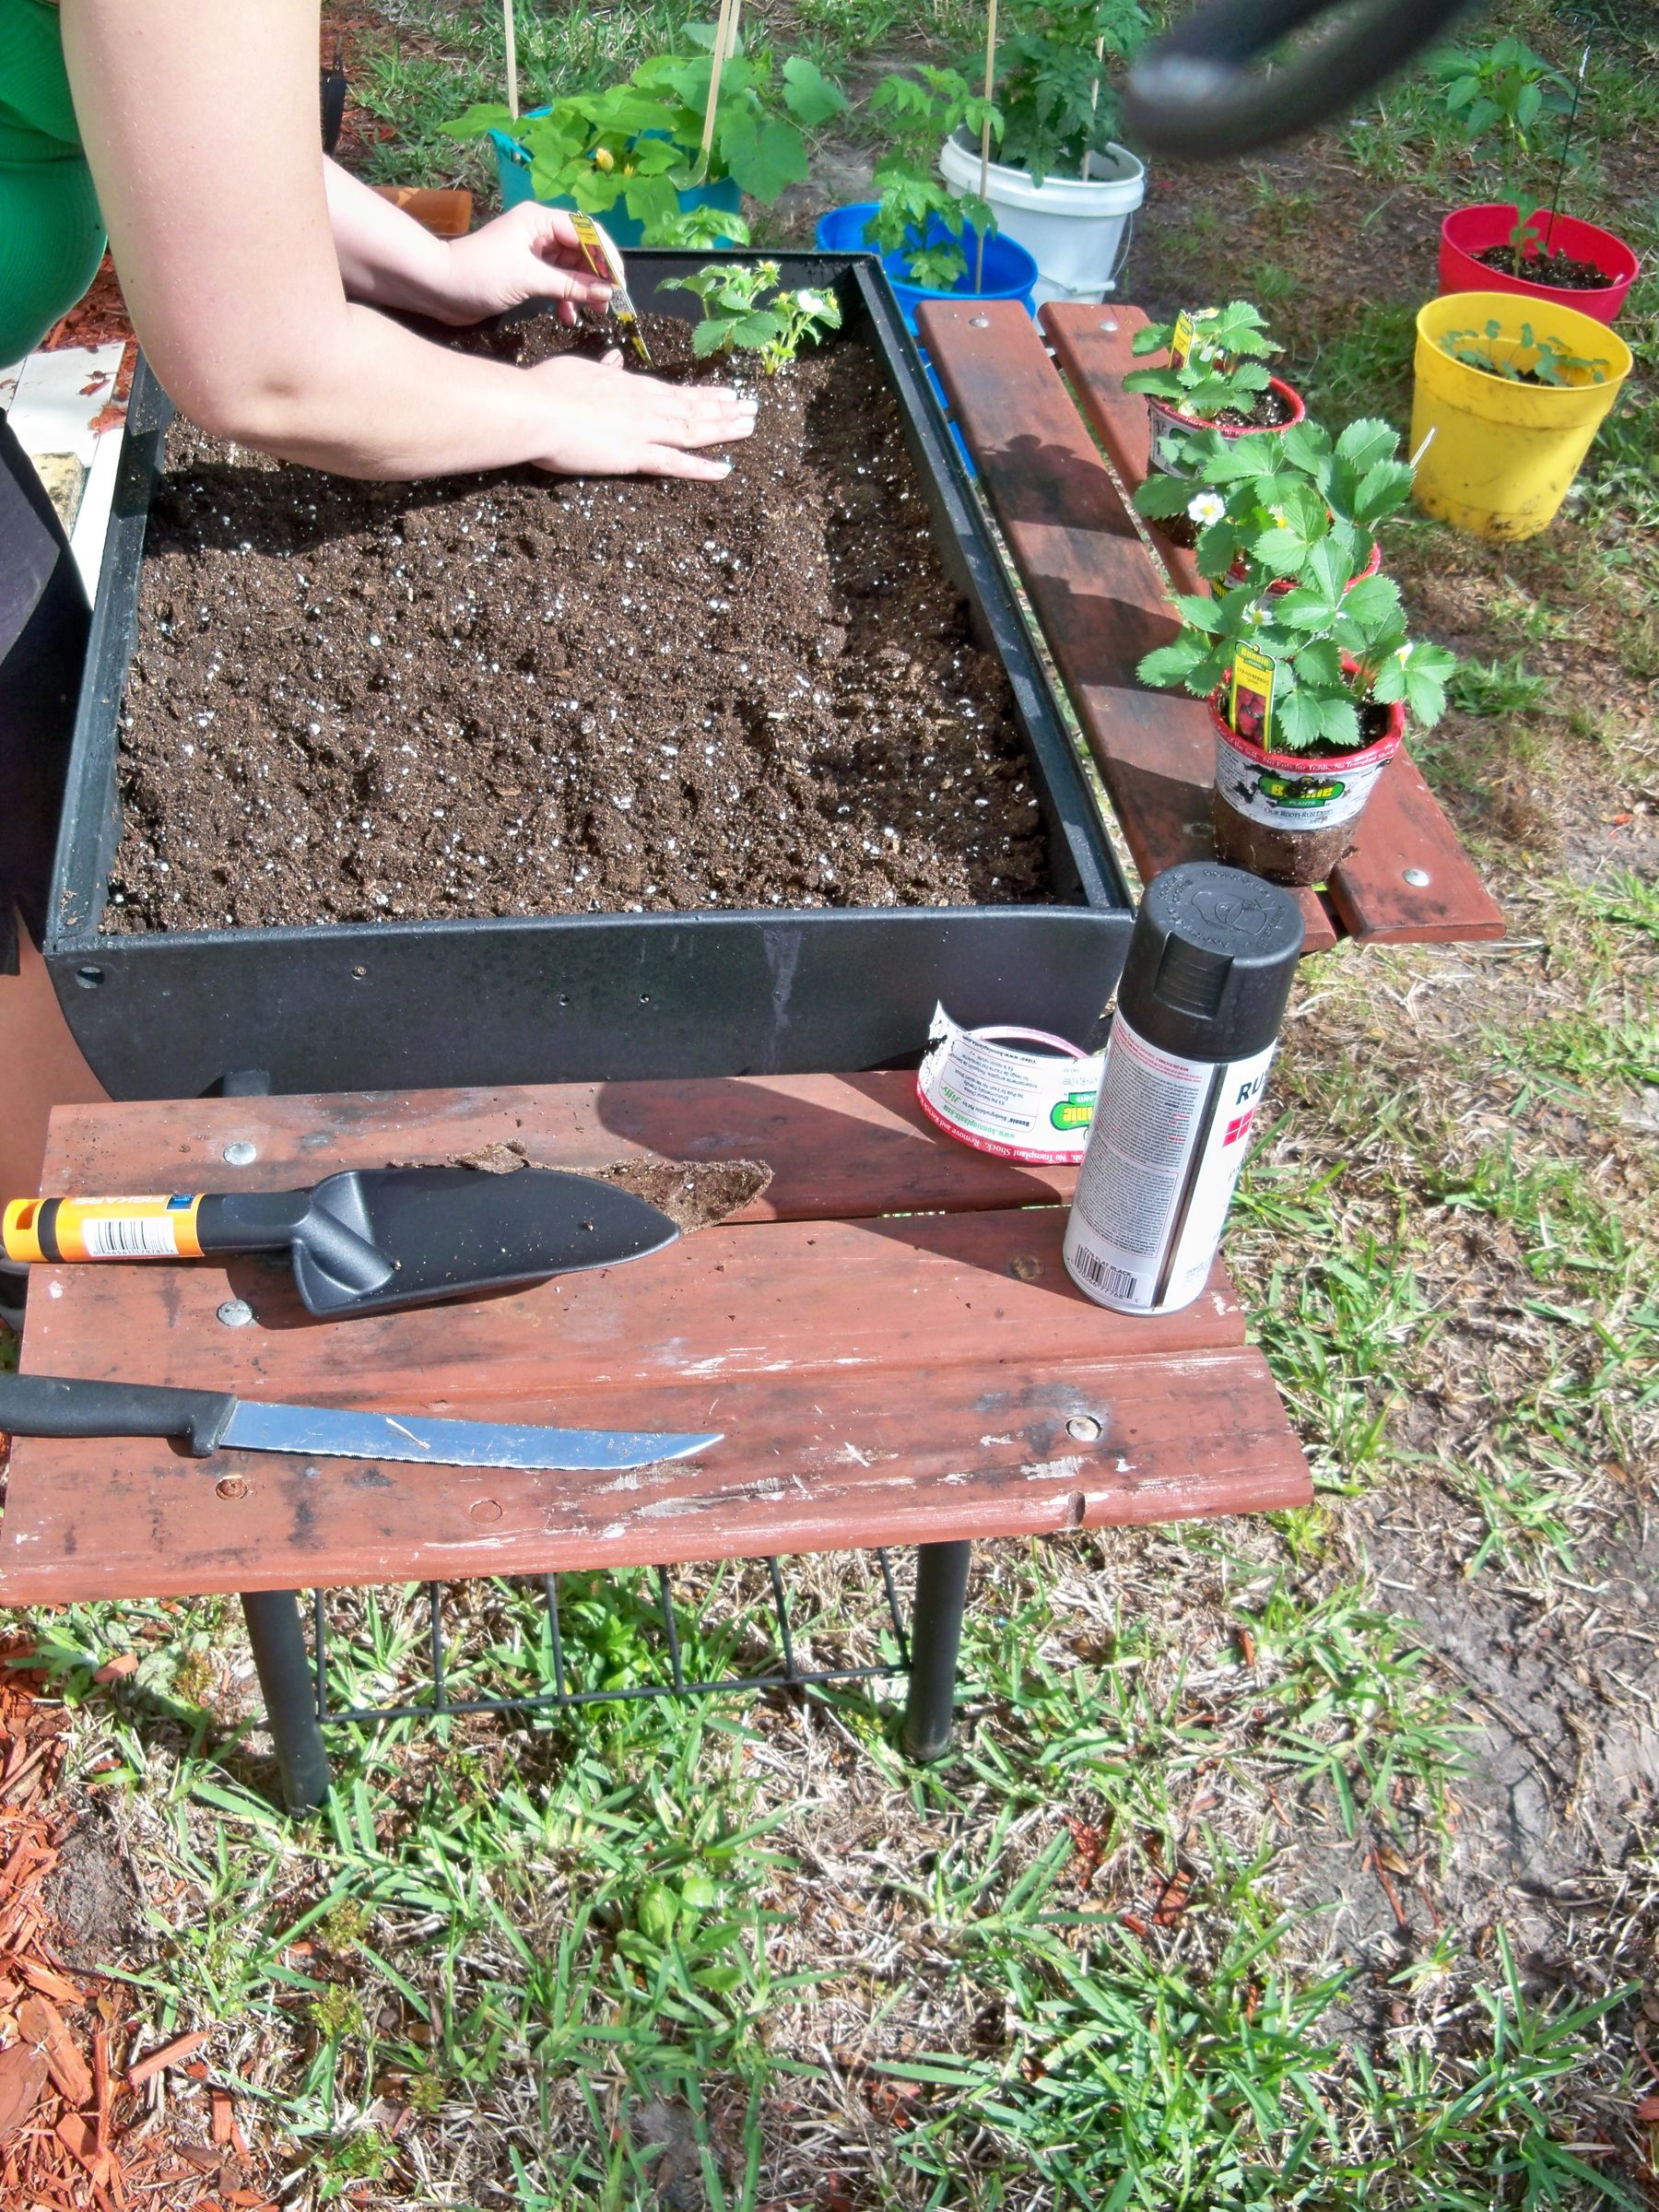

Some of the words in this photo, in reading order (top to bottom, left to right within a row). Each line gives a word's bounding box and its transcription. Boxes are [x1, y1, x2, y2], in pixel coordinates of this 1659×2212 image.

[943, 1087, 961, 1102] Jiffy
[940, 1120, 951, 1131] and
[951, 1129, 980, 1147] Remove
[985, 1142, 1012, 1157] Shock.
[1014, 1149, 1053, 1162] Transplant
